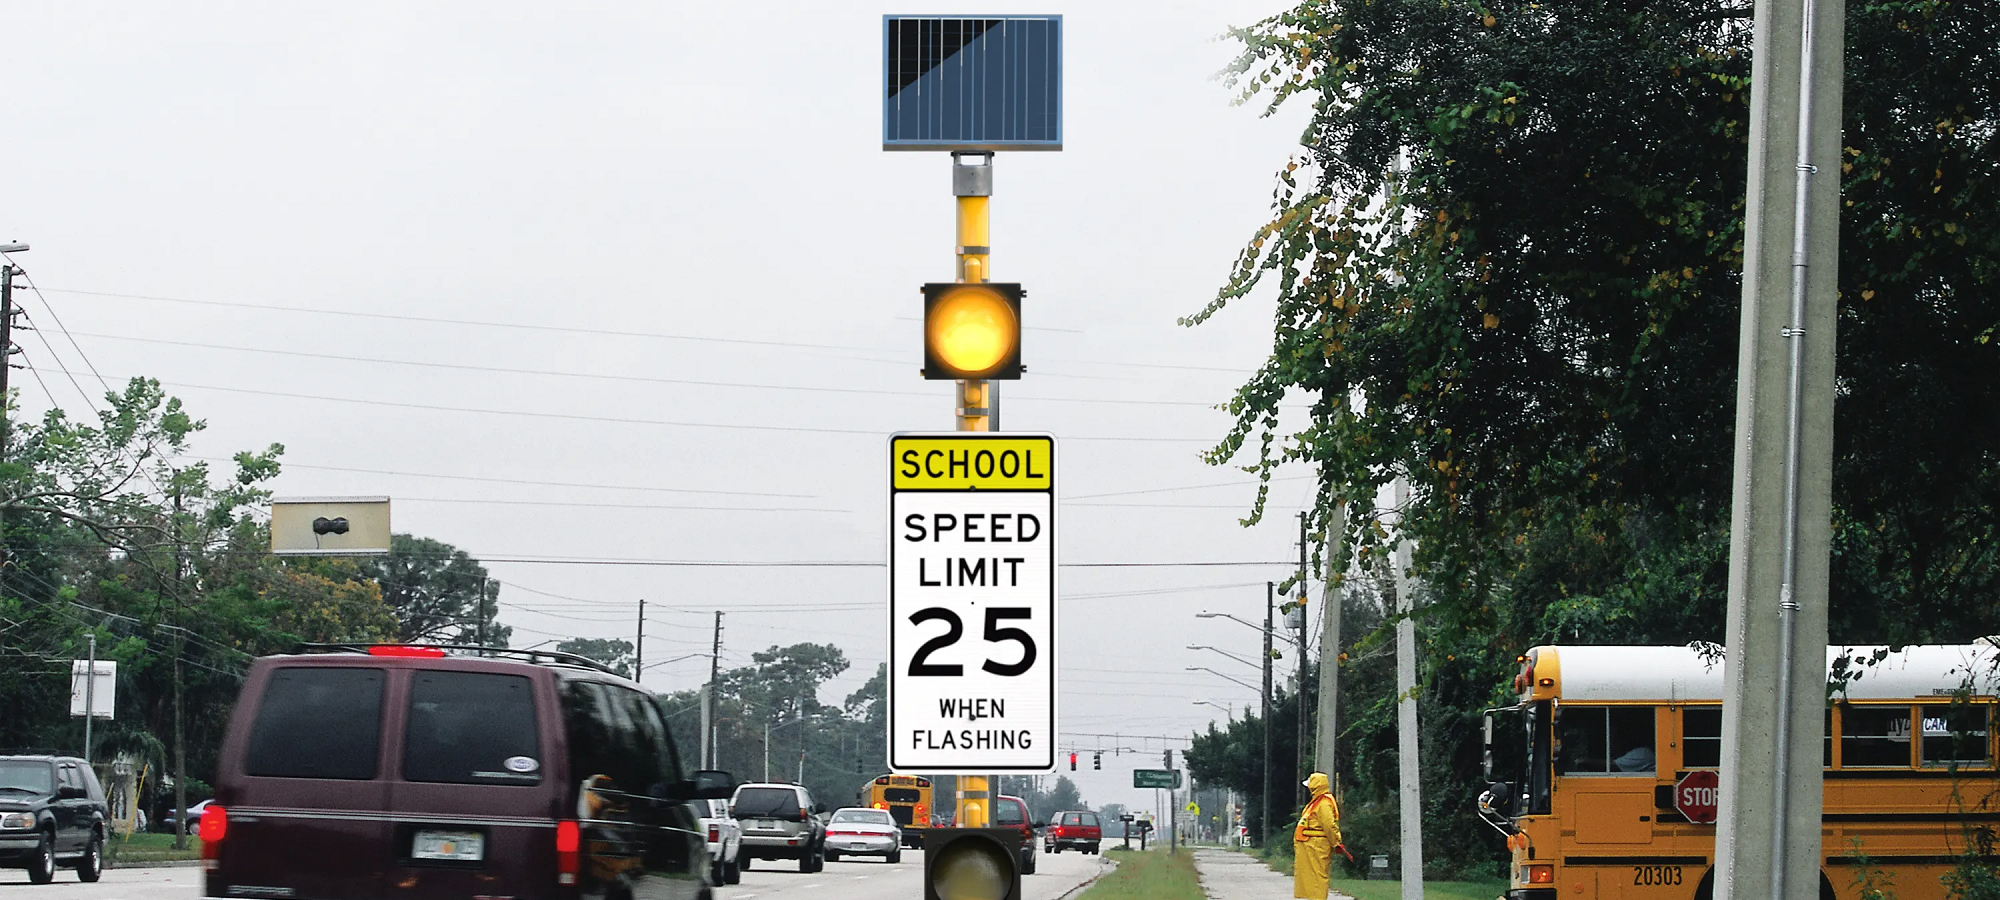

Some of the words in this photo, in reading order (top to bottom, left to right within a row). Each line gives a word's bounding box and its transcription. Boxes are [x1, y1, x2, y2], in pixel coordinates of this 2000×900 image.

[901, 449, 1044, 479] SCHOOL
[904, 513, 1041, 542] SPEED
[919, 557, 1025, 587] LIMIT
[907, 606, 1037, 677] 25
[939, 698, 1005, 719] WHEN
[912, 730, 1032, 750] FLASHING
[1633, 866, 1682, 886] 20303
